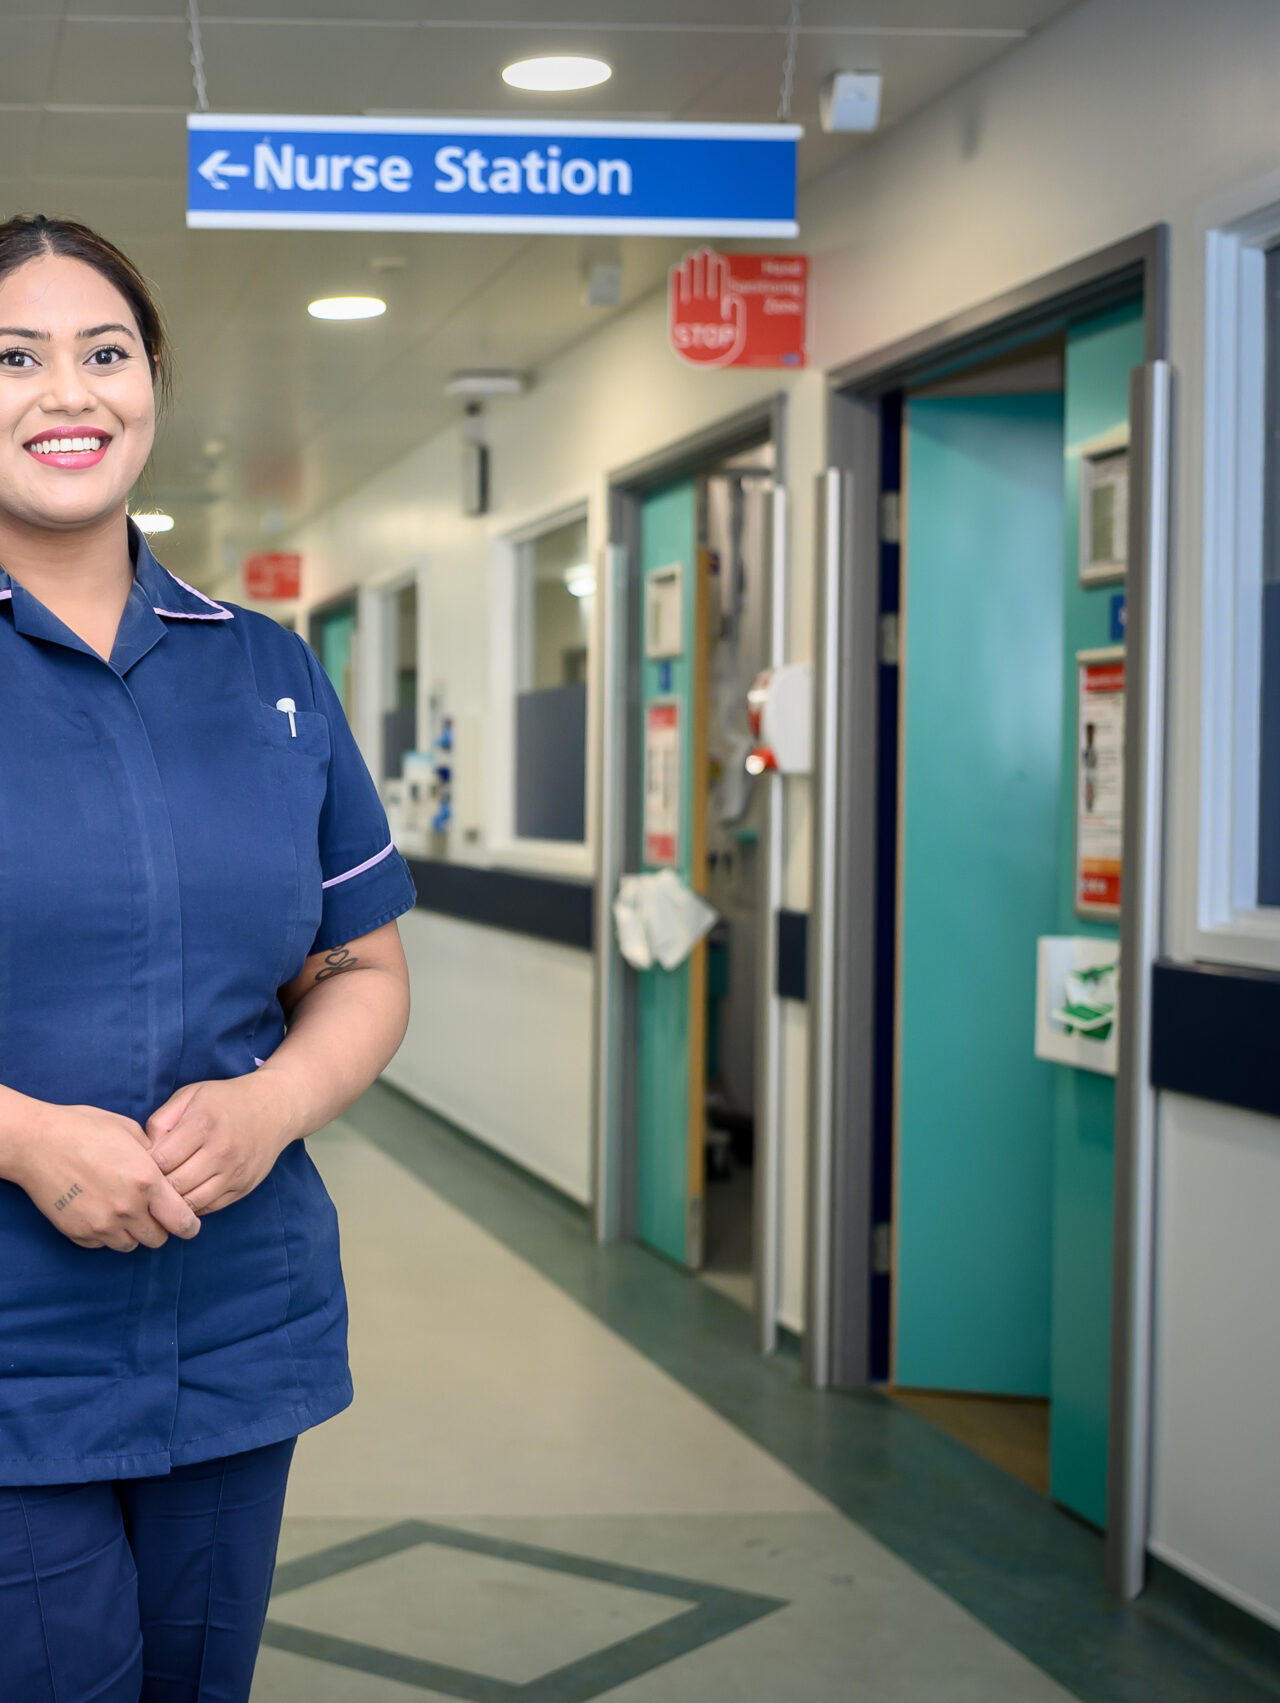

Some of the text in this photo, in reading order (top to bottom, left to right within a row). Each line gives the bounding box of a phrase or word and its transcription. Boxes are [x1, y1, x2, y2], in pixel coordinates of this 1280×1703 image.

[253, 143, 633, 196] Nurse Station
[674, 323, 737, 348] STOP
[54, 1183, 83, 1211] CREATE
